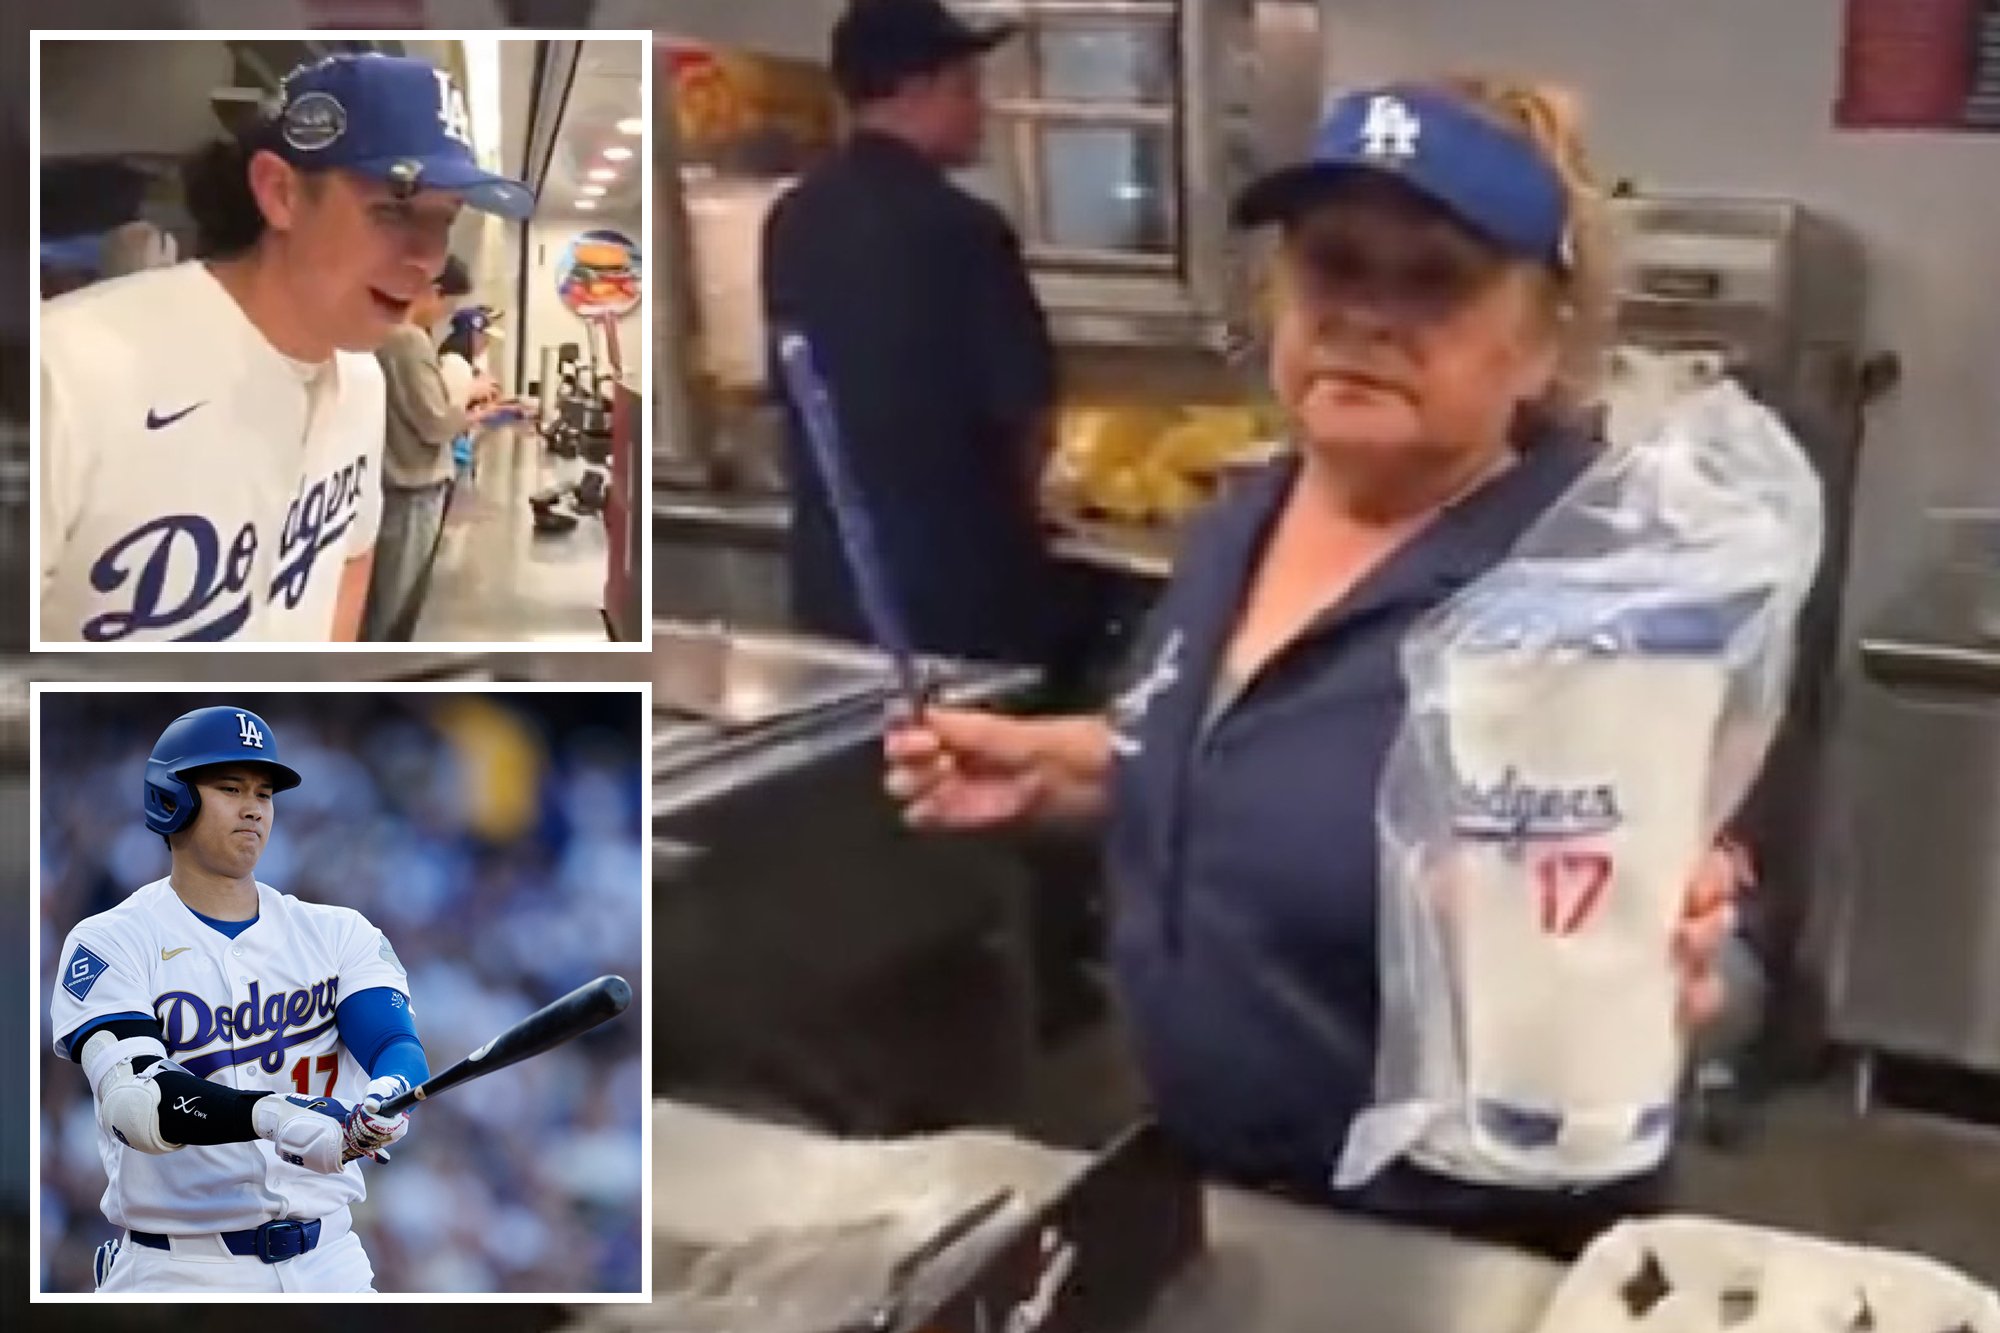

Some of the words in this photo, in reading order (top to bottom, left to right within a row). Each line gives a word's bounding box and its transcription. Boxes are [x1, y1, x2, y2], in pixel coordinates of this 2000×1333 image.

[1361, 95, 1421, 155] LA
[236, 713, 264, 749] LA
[1535, 851, 1613, 938] 17
[153, 974, 340, 1075] Dodgers
[290, 1051, 340, 1099] 17
